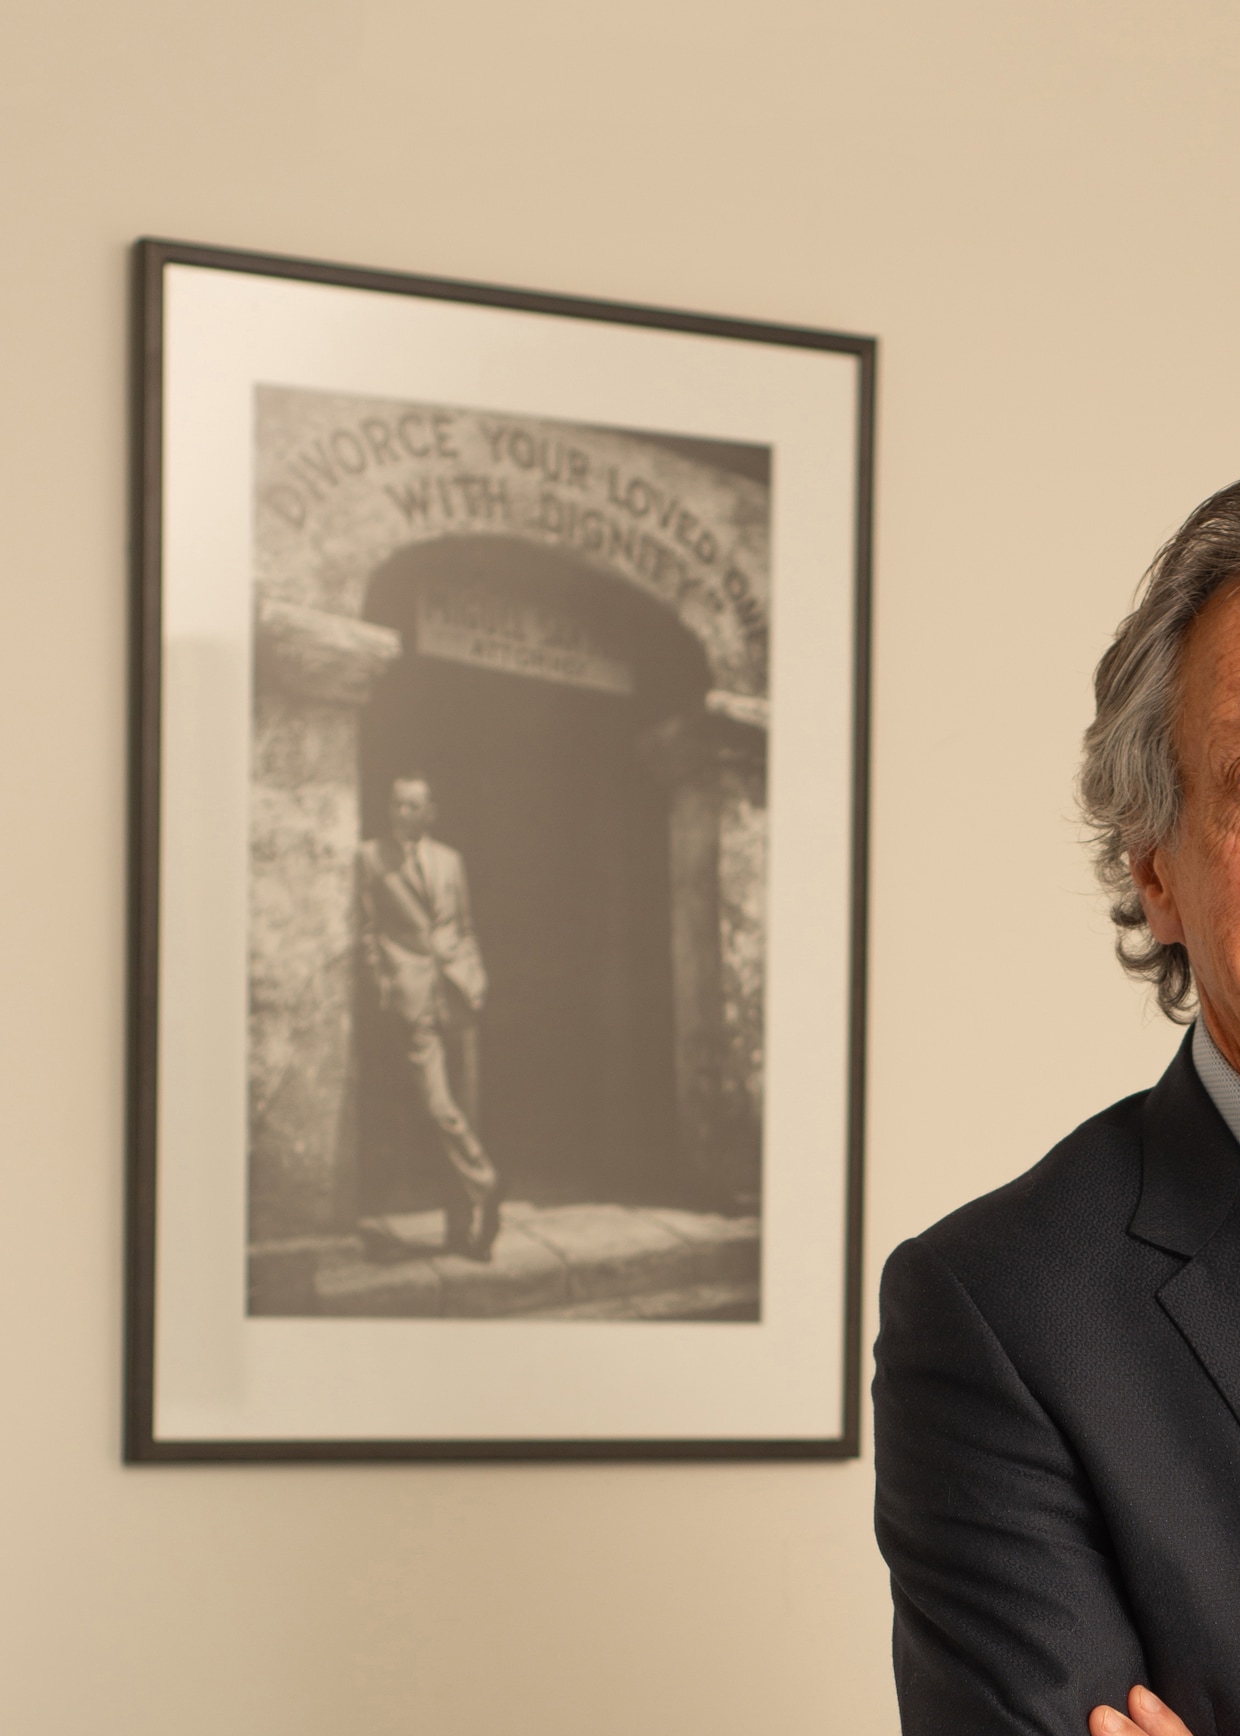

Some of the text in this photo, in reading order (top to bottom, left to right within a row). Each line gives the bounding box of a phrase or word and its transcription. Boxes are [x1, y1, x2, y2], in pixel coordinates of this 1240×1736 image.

[262, 413, 460, 533] DIVORCE
[479, 419, 590, 491] YOUR
[607, 465, 717, 566] LOVED
[383, 472, 513, 522] WITH
